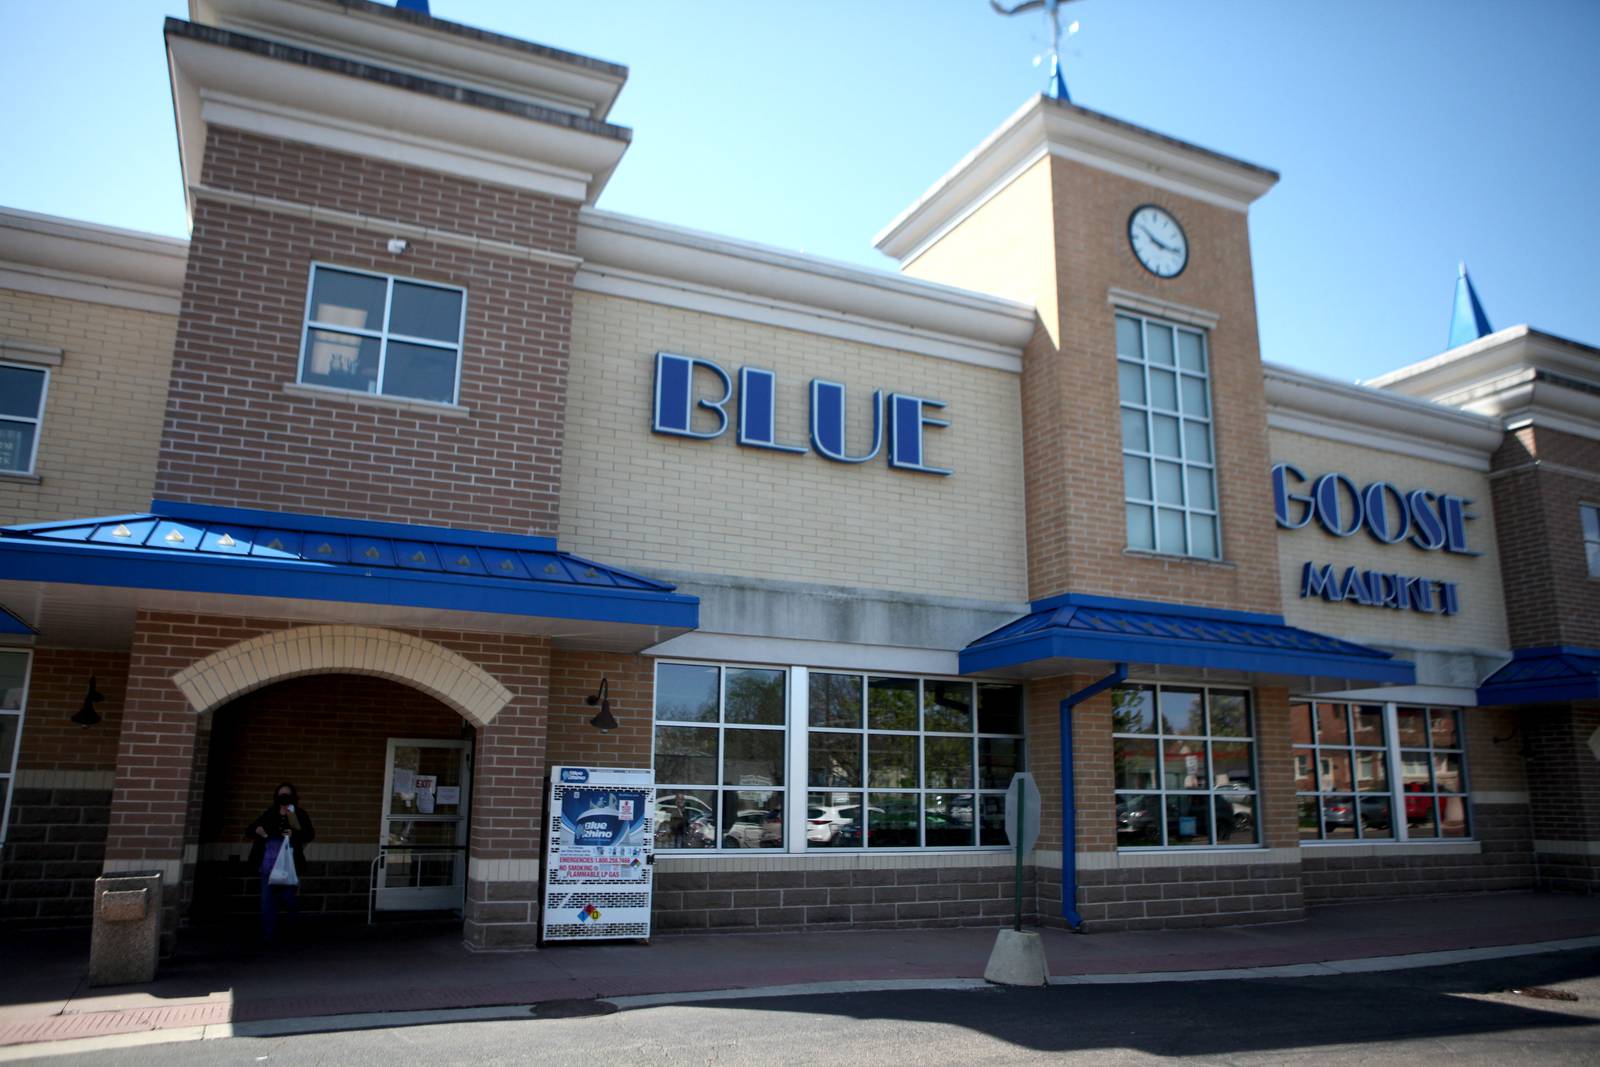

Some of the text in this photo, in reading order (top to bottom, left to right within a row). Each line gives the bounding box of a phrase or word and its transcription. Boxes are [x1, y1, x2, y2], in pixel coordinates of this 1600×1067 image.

[651, 351, 954, 476] BLUE
[1271, 461, 1485, 557] GOOSE
[1301, 560, 1460, 616] MARKET
